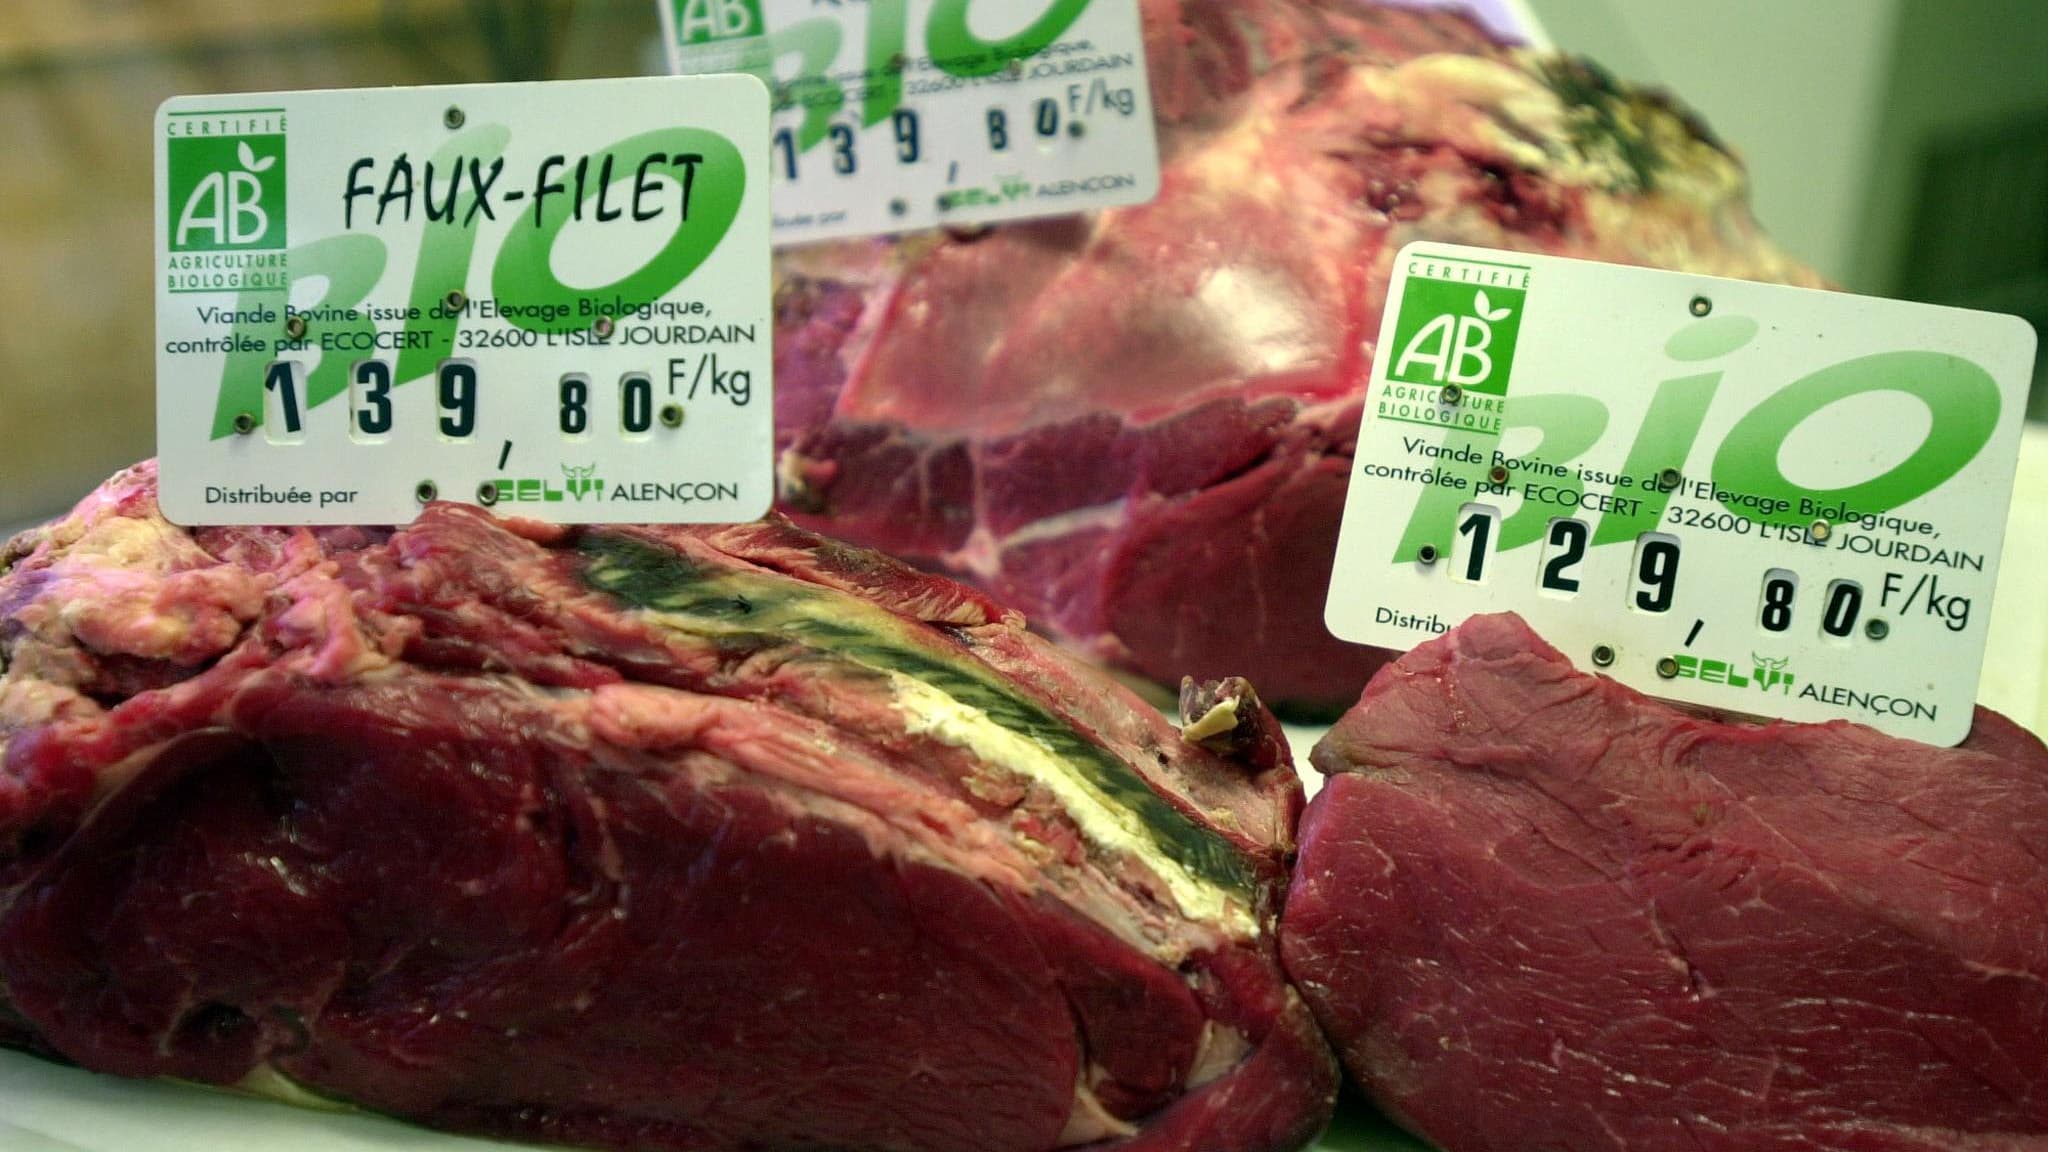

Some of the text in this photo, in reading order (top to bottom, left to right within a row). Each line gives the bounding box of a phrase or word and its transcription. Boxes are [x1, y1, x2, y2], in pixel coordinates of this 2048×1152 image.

[1067, 77, 1135, 116] F/kg
[167, 115, 287, 136] CERTIFIÉ
[343, 152, 703, 229] FAUX-FILET
[176, 171, 268, 246] AB
[168, 253, 287, 270] AGRICULTURE
[1408, 262, 1531, 288] CERTIFIÉ
[168, 272, 287, 288] BIOLOGIQUE
[197, 303, 276, 324] Viande
[285, 301, 359, 321] Bovine
[367, 298, 424, 320] issue
[465, 298, 570, 322] l'Elevage
[578, 296, 711, 320] Biologique,
[166, 333, 266, 353] contrôlée
[274, 337, 312, 355] par
[321, 331, 432, 350] ECOCERT
[459, 329, 538, 348] 32600
[620, 324, 755, 344] JOURDAIN
[1395, 313, 1493, 385] AB
[668, 353, 751, 406] F/kg
[1378, 401, 1501, 431] BIOLOGIQUE
[1382, 385, 1504, 414] AGRICTURE
[205, 486, 312, 504] Distribuée
[320, 491, 358, 508] par
[611, 483, 738, 504] ALENÇON
[1403, 436, 1483, 465] Viande
[1492, 450, 1568, 478] Bovine
[1577, 463, 1633, 488] issue
[1680, 477, 1791, 515] l'Elevage
[1799, 498, 1940, 538] Biologique,
[1364, 463, 1467, 490] contrôlée
[1474, 482, 1516, 497] par
[1524, 484, 1642, 517] ECOCERT
[1667, 506, 1751, 534] 32600
[1837, 533, 1984, 572] JOURDAIN
[1881, 573, 1971, 632] F/kg
[1799, 682, 1938, 722] ALENÇON
